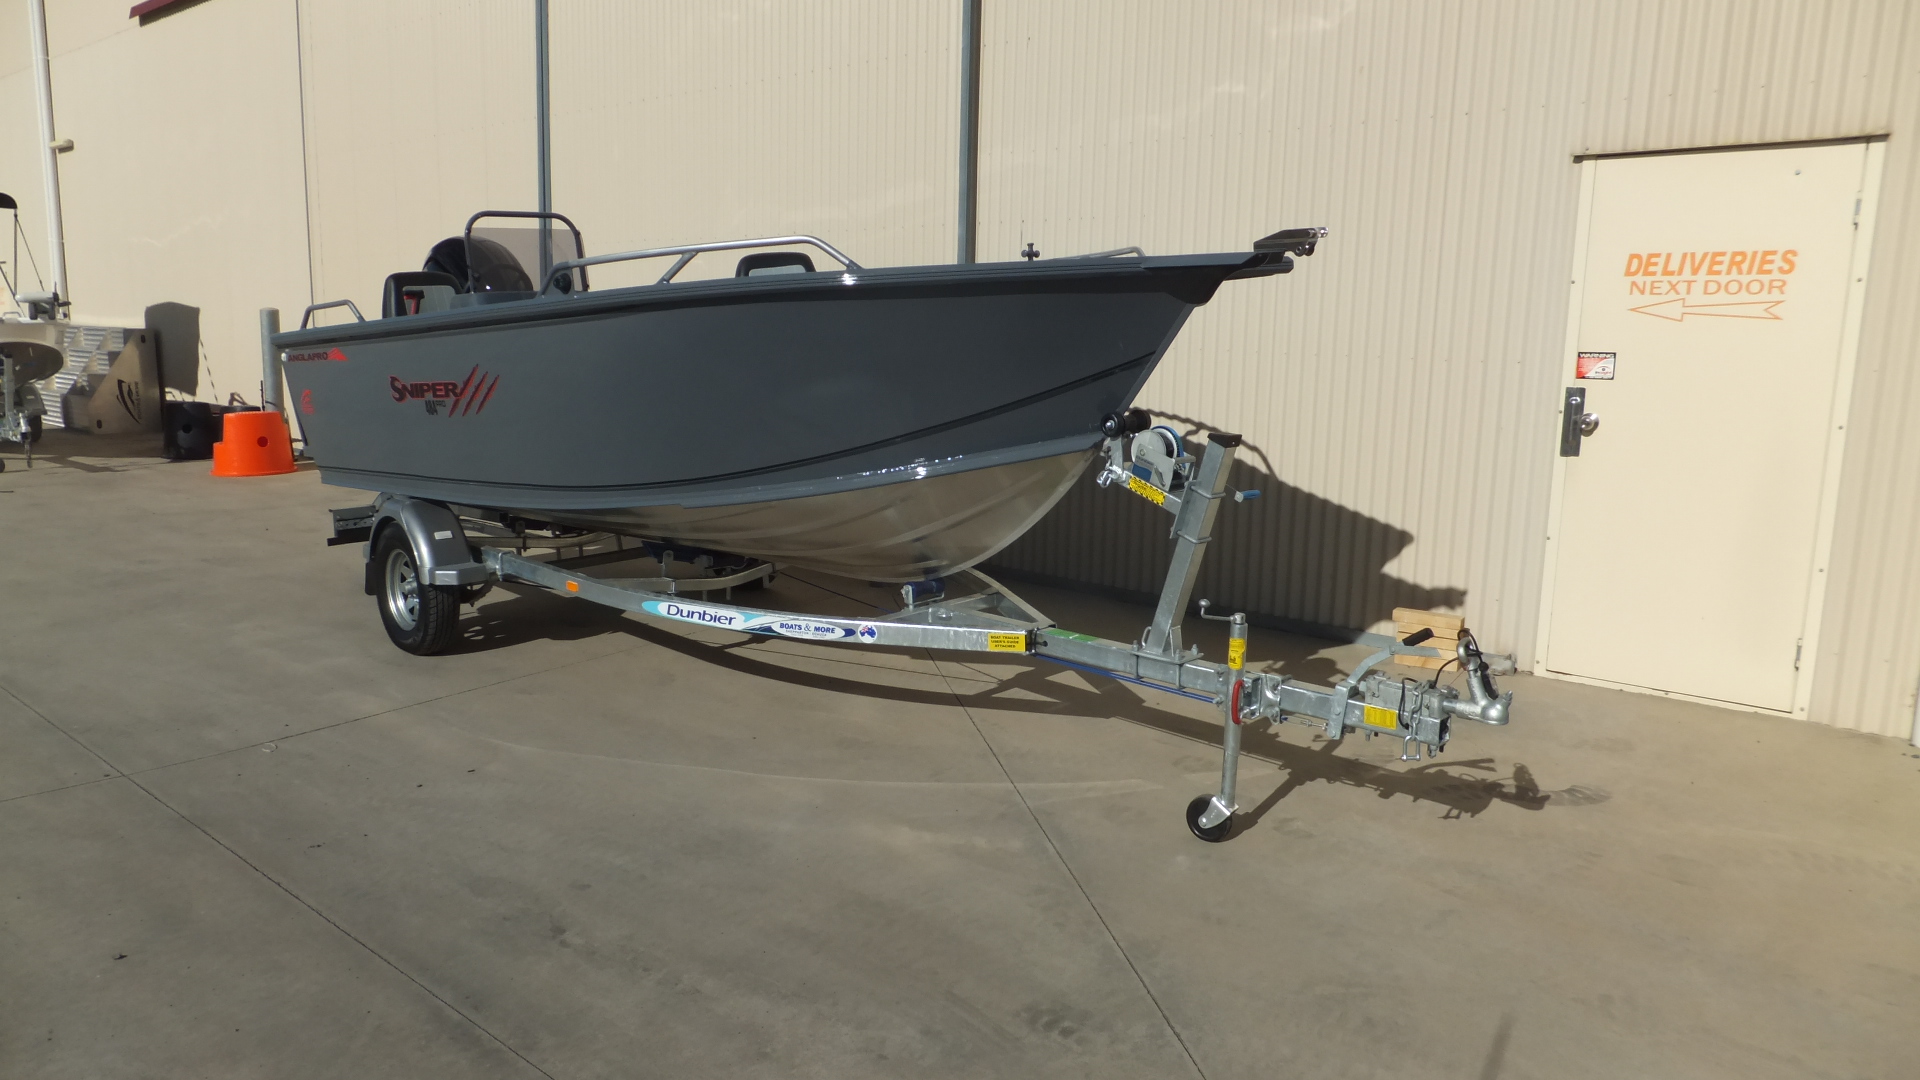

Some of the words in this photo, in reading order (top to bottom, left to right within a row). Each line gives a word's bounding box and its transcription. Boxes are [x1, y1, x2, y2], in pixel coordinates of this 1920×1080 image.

[1623, 249, 1799, 277] DELIVERIES
[1629, 279, 1697, 296] NEXT
[1702, 278, 1788, 296] DOOR
[288, 351, 328, 362] ANGLAPRO
[389, 375, 461, 404] SNIPER
[666, 604, 737, 626] Dunbier
[779, 622, 803, 631] BOATS
[803, 623, 812, 632] &
[813, 625, 836, 634] MORE
